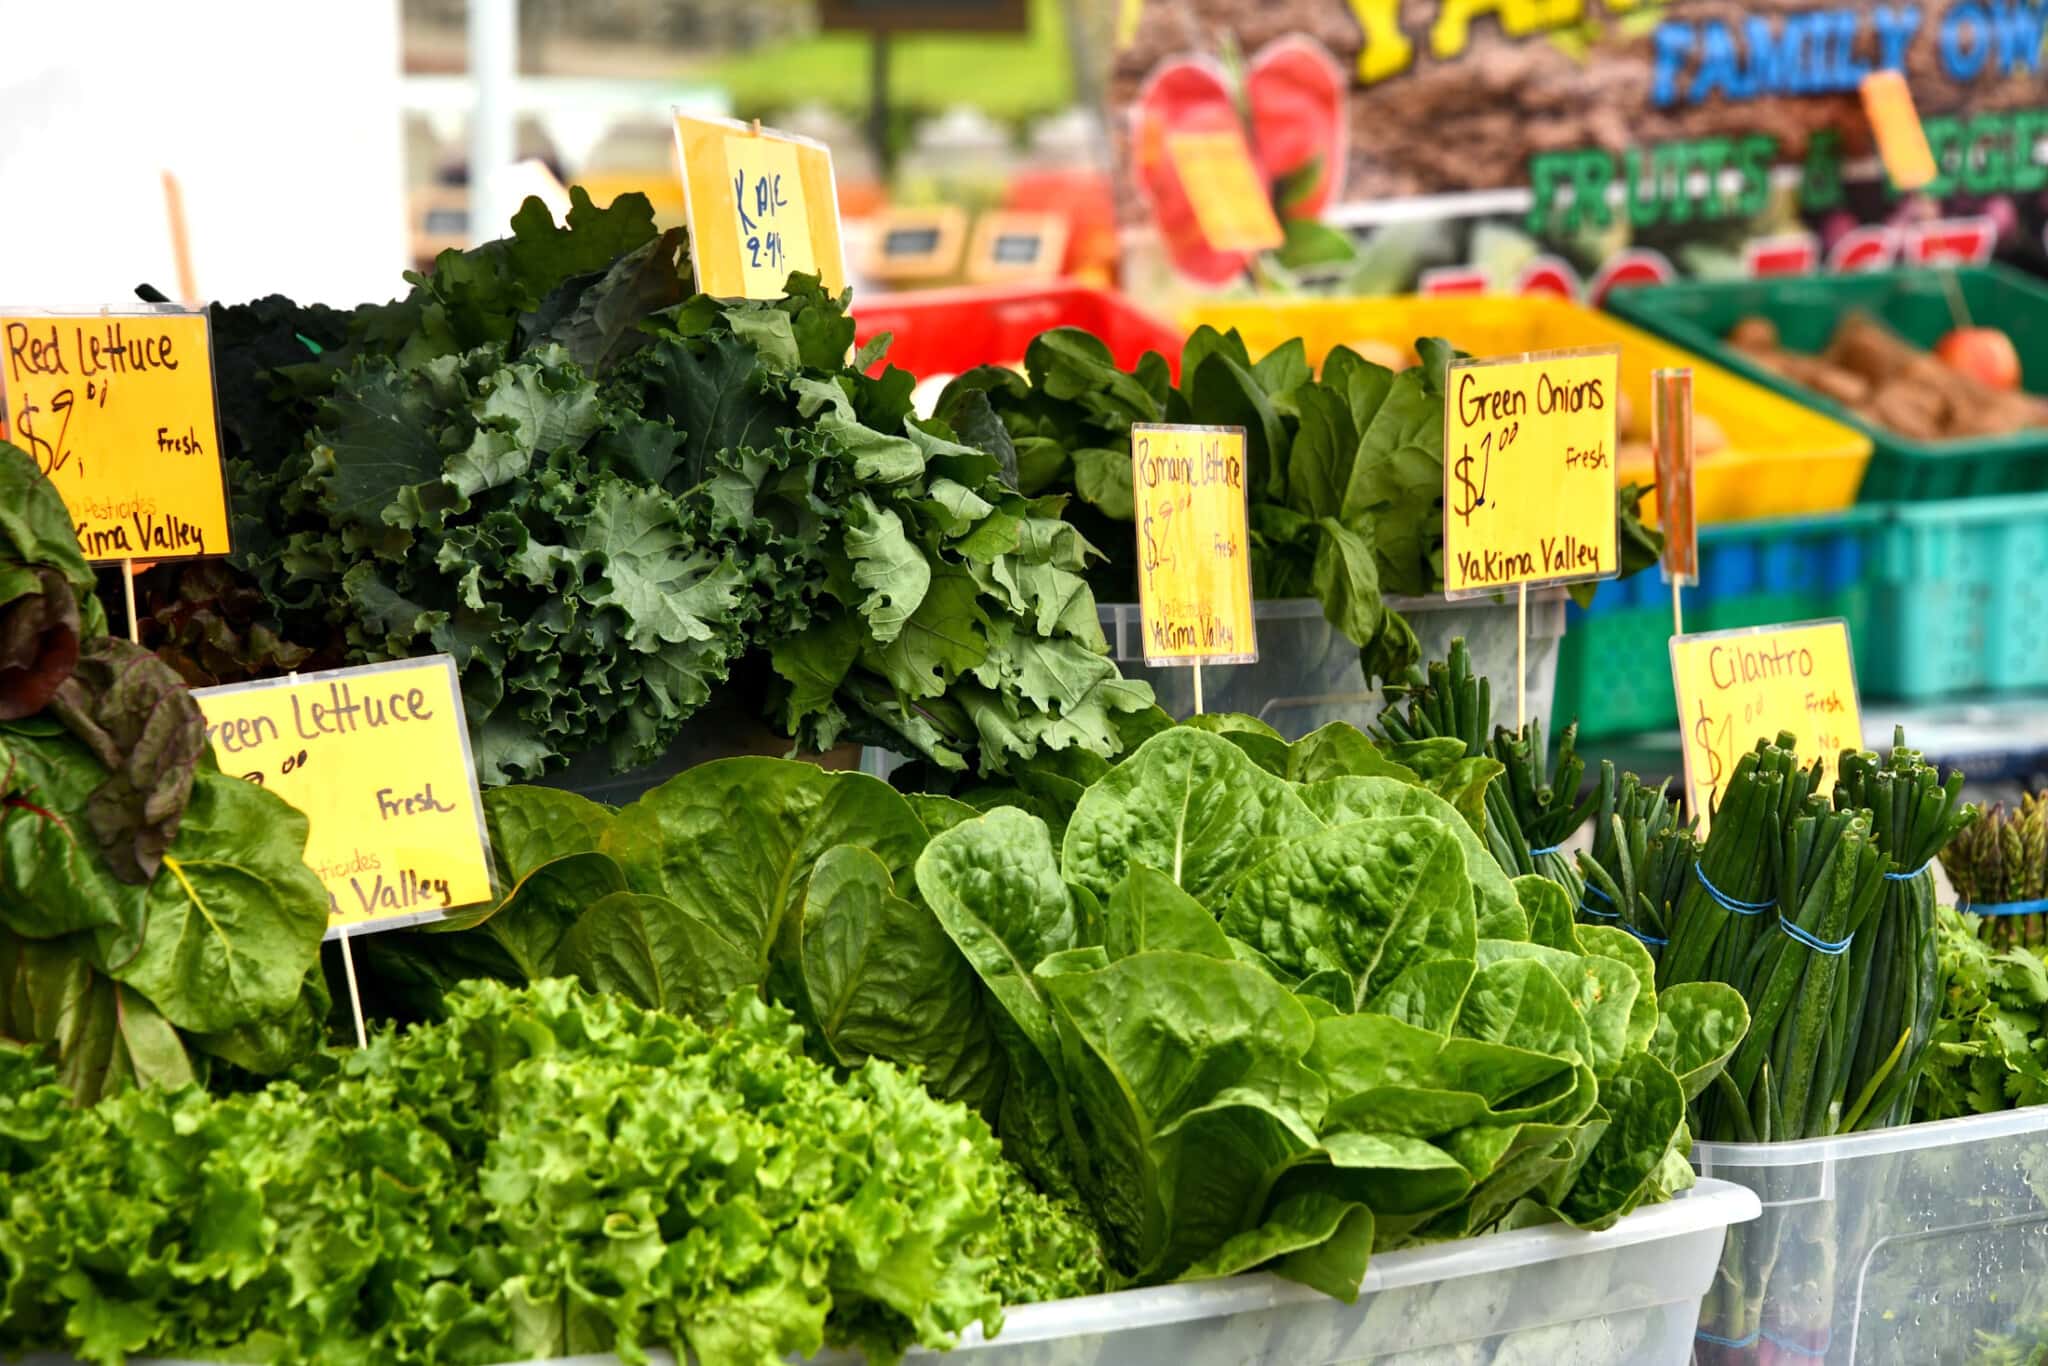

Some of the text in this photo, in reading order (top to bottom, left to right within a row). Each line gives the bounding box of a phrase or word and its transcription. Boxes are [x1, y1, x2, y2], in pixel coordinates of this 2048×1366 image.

[1652, 5, 1921, 106] FAMILY
[1525, 132, 1778, 232] FRUITS
[6, 322, 69, 382] Red
[1459, 372, 1605, 427] Green Onions
[157, 426, 203, 455] Fresh
[1565, 440, 1609, 470] Fresh
[1138, 437, 1199, 490] Romaine
[132, 511, 205, 555] Valley
[1214, 532, 1239, 560] Fresh
[1540, 535, 1600, 572] Valley
[1199, 615, 1234, 653] Valley
[1709, 640, 1813, 690] Cilantro
[1805, 689, 1845, 713] Fresh
[205, 715, 279, 752] reen
[376, 783, 456, 820] Fresh
[350, 868, 452, 916] Valley
